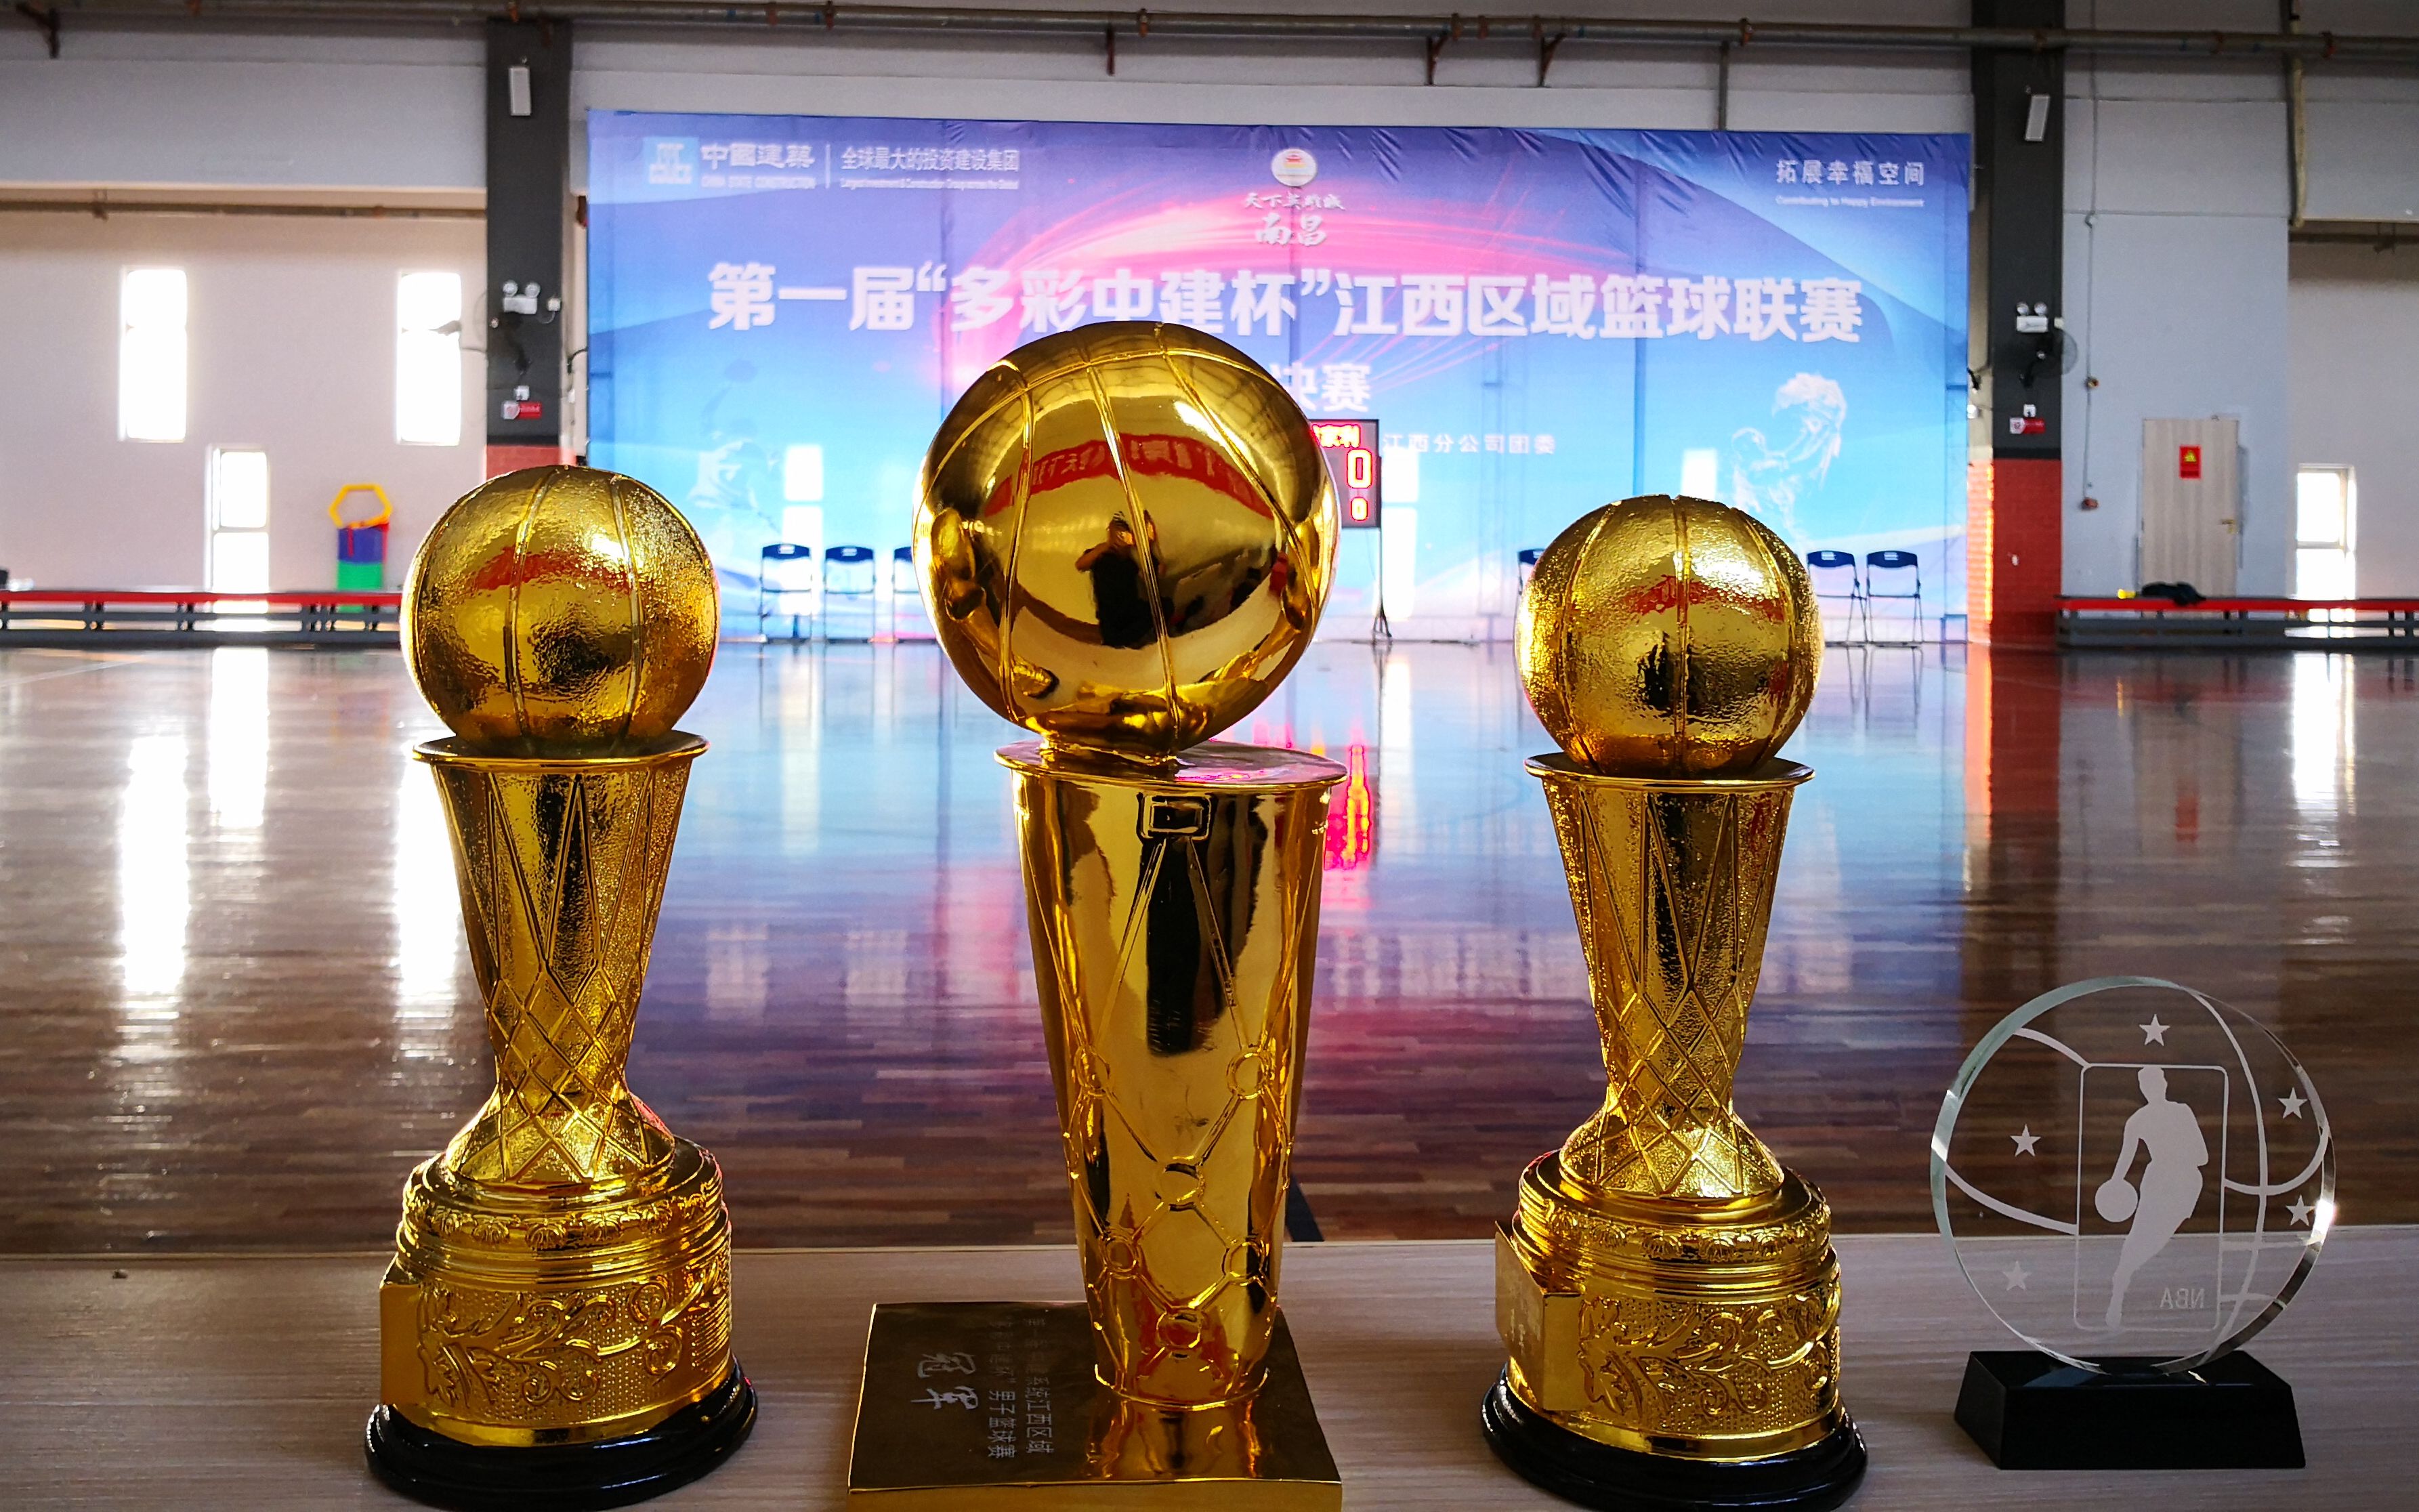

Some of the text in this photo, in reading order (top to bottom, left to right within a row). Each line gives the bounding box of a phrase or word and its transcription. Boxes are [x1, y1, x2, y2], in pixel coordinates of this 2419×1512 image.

[841, 146, 1019, 172] 全球最大的投资建设集团
[1775, 159, 1924, 186] 拓展幸福空间
[1255, 212, 1328, 247] 南昌
[1347, 448, 1372, 488] 0
